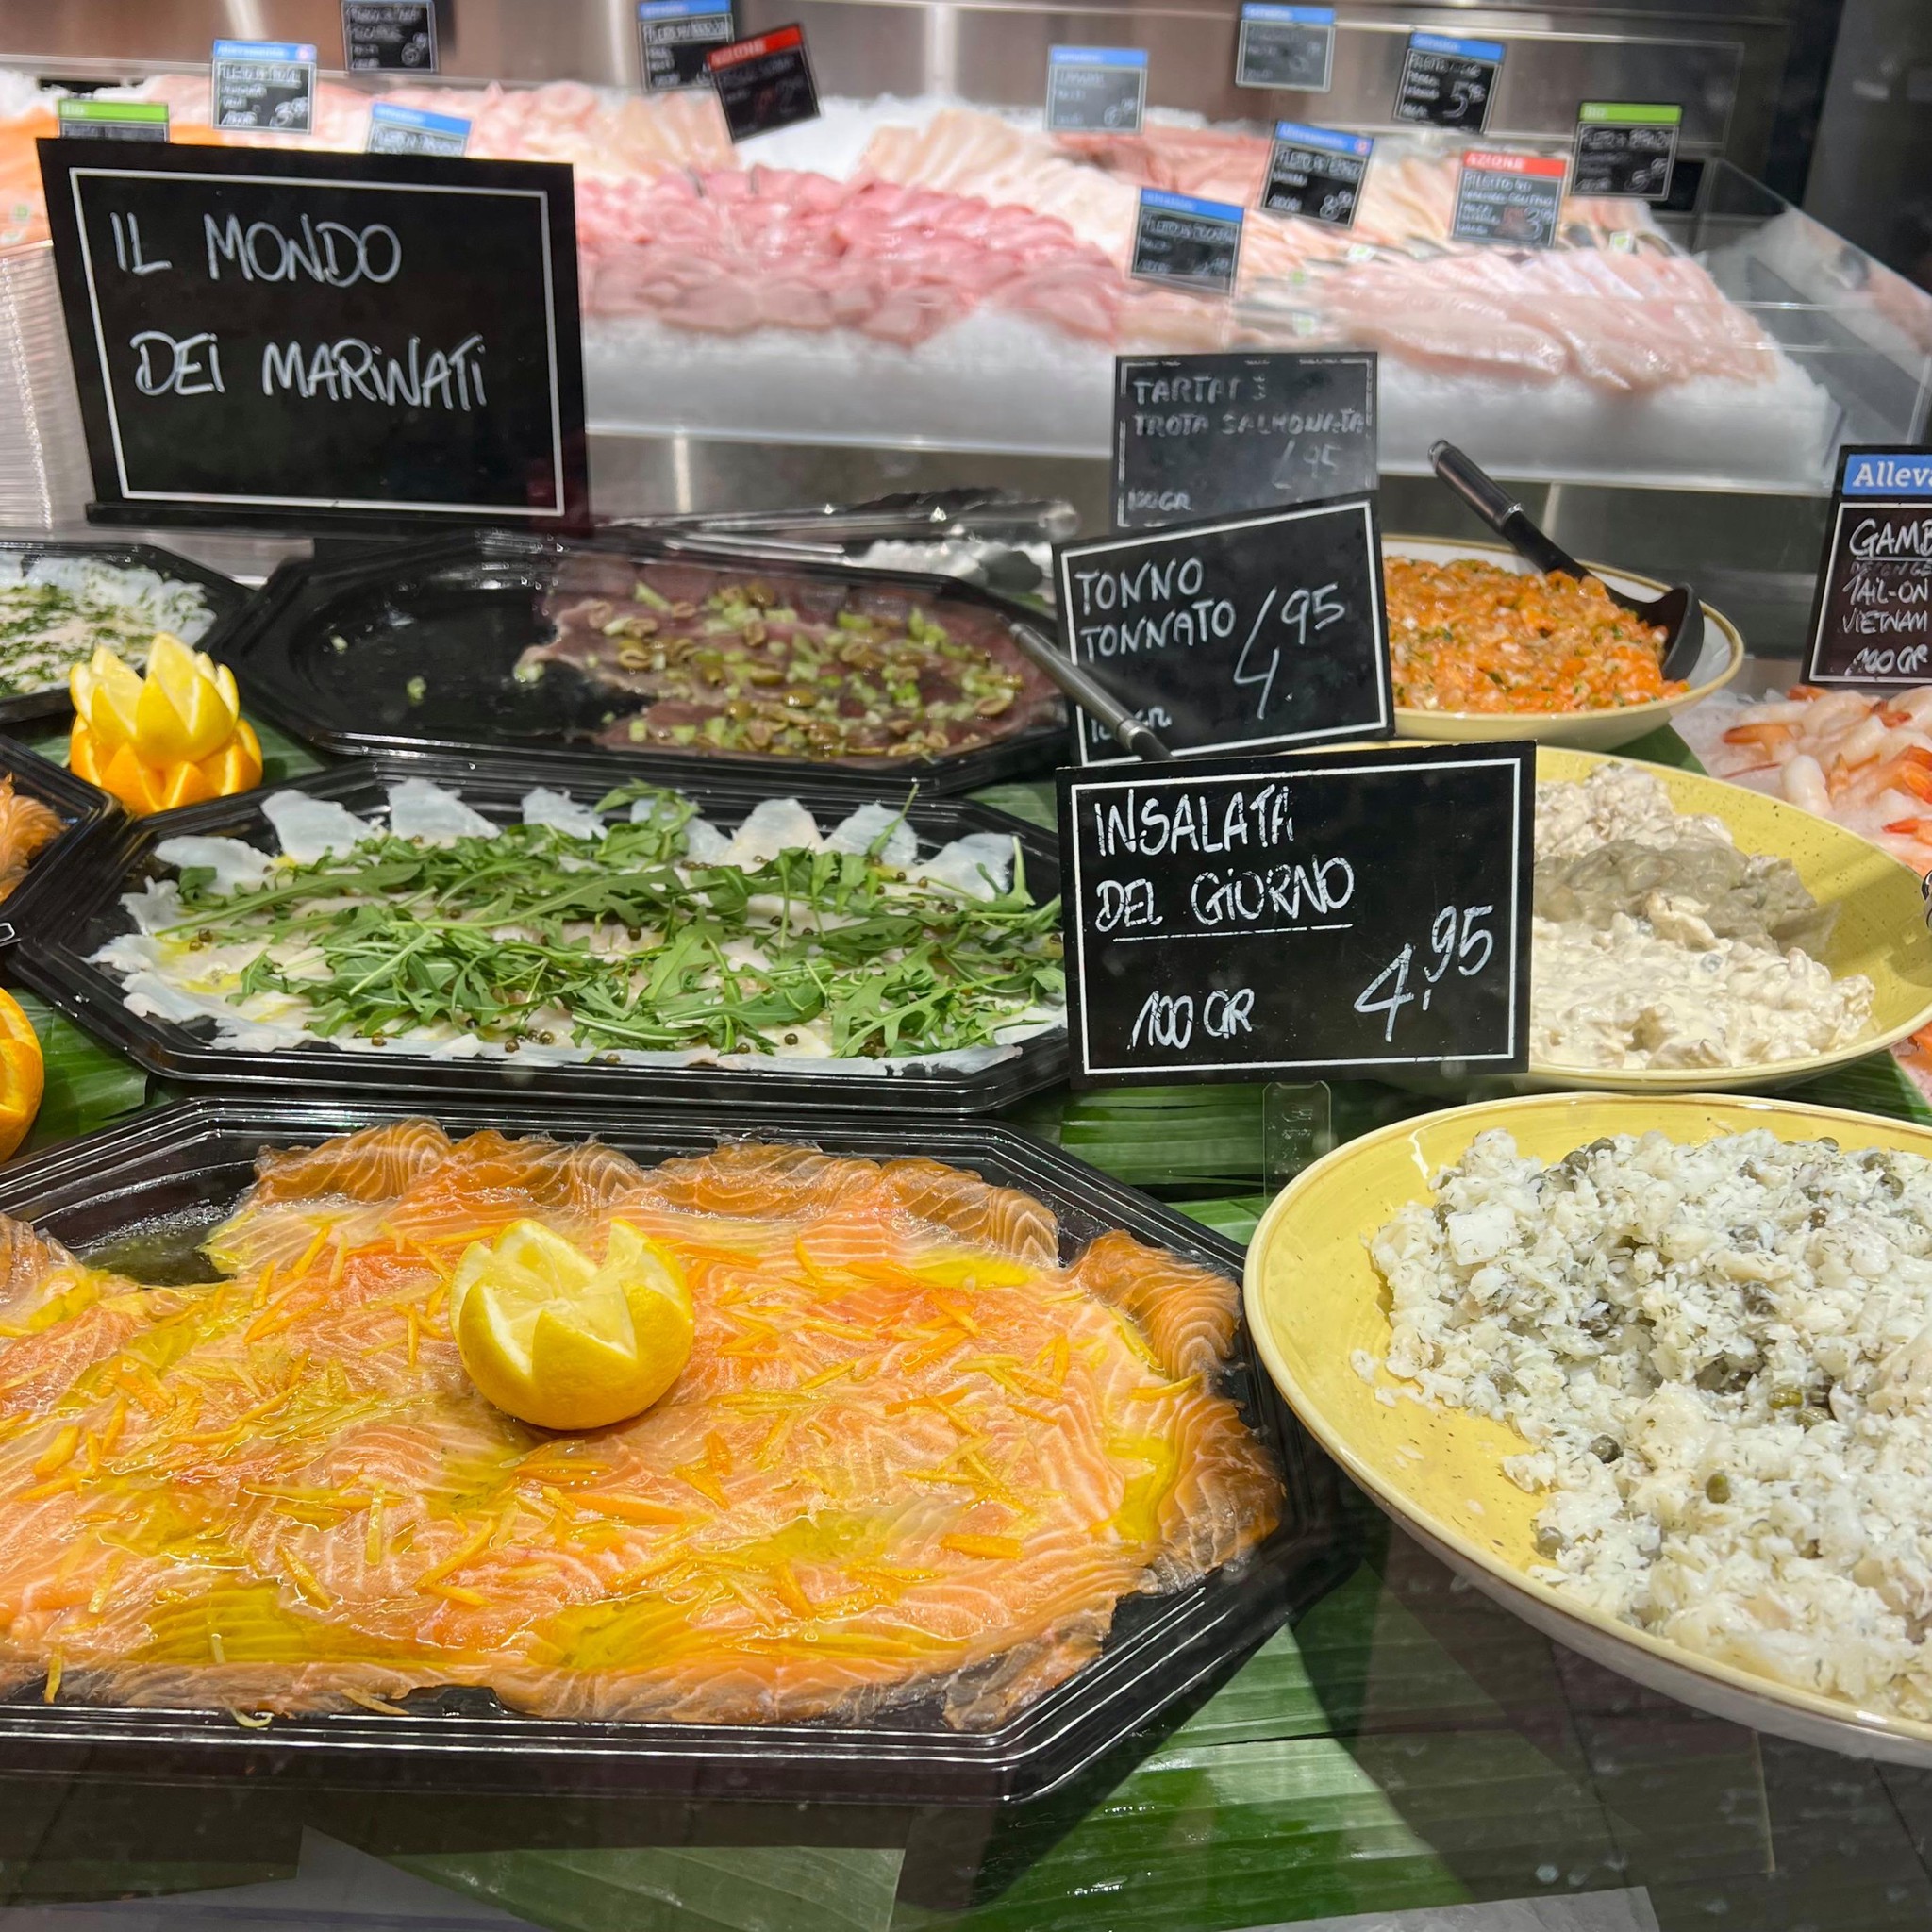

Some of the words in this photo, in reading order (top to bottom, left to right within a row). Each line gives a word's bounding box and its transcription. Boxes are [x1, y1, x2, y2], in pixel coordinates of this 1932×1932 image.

[110, 212, 172, 275] IL
[204, 213, 402, 287] MONDO
[129, 330, 225, 395] DEI
[1134, 412, 1209, 437] TROTA
[1074, 557, 1204, 616] TONNO
[1080, 598, 1237, 664] TONNATO
[1842, 607, 1928, 634] VIETNAM
[1095, 782, 1295, 857] INSALATA
[1095, 877, 1163, 933] DEL
